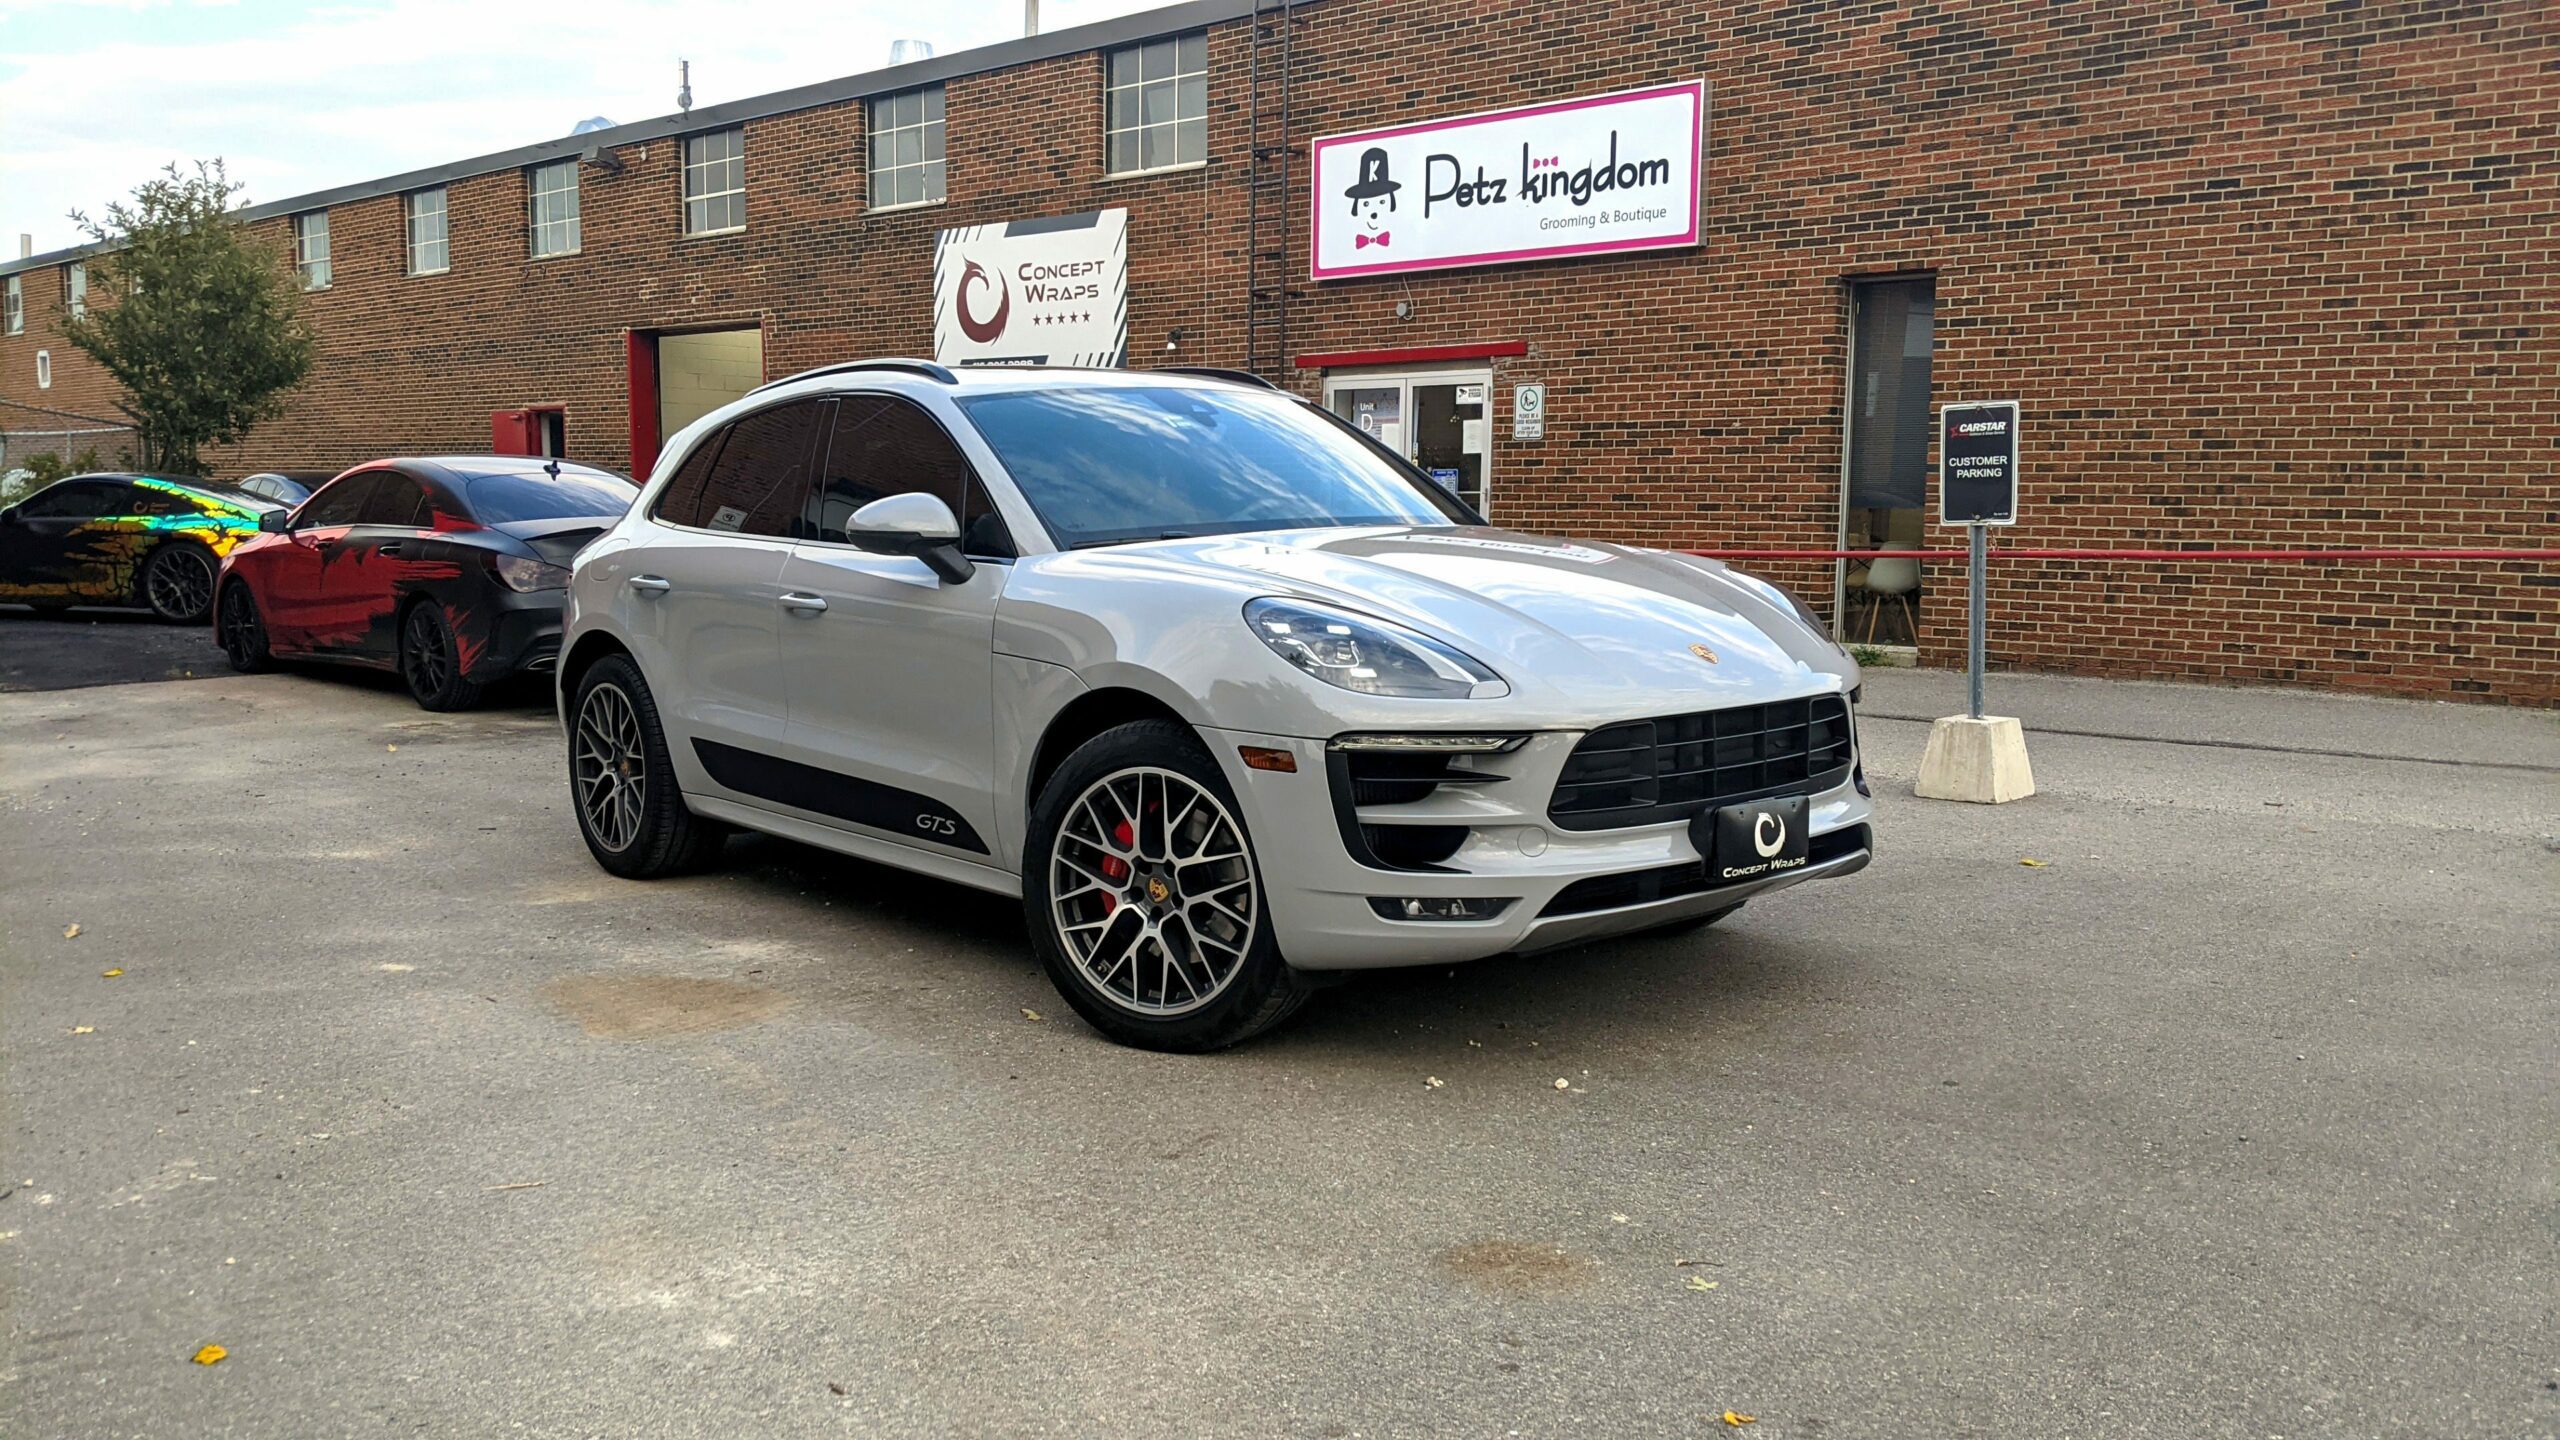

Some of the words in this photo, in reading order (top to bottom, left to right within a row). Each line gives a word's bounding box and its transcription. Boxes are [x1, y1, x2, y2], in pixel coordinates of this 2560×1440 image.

[1369, 160, 1380, 182] K
[1424, 153, 1507, 219] Petz
[1517, 130, 1669, 206] kingdom
[1540, 215, 1596, 230] Grooming
[1600, 211, 1610, 224] &
[1614, 207, 1667, 222] Boutique
[1018, 260, 1105, 281] CONCEPT
[1025, 284, 1099, 303] WRAPS
[1360, 402, 1374, 411] Unit
[1361, 413, 1373, 432] D
[1959, 421, 2007, 432] CARSTAR
[1949, 456, 2008, 467] CUSTOMER
[1957, 468, 2002, 478] PARKING
[916, 814, 956, 835] GTS
[1722, 863, 1768, 878] CONCEPT
[1771, 857, 1806, 870] WRAPS
